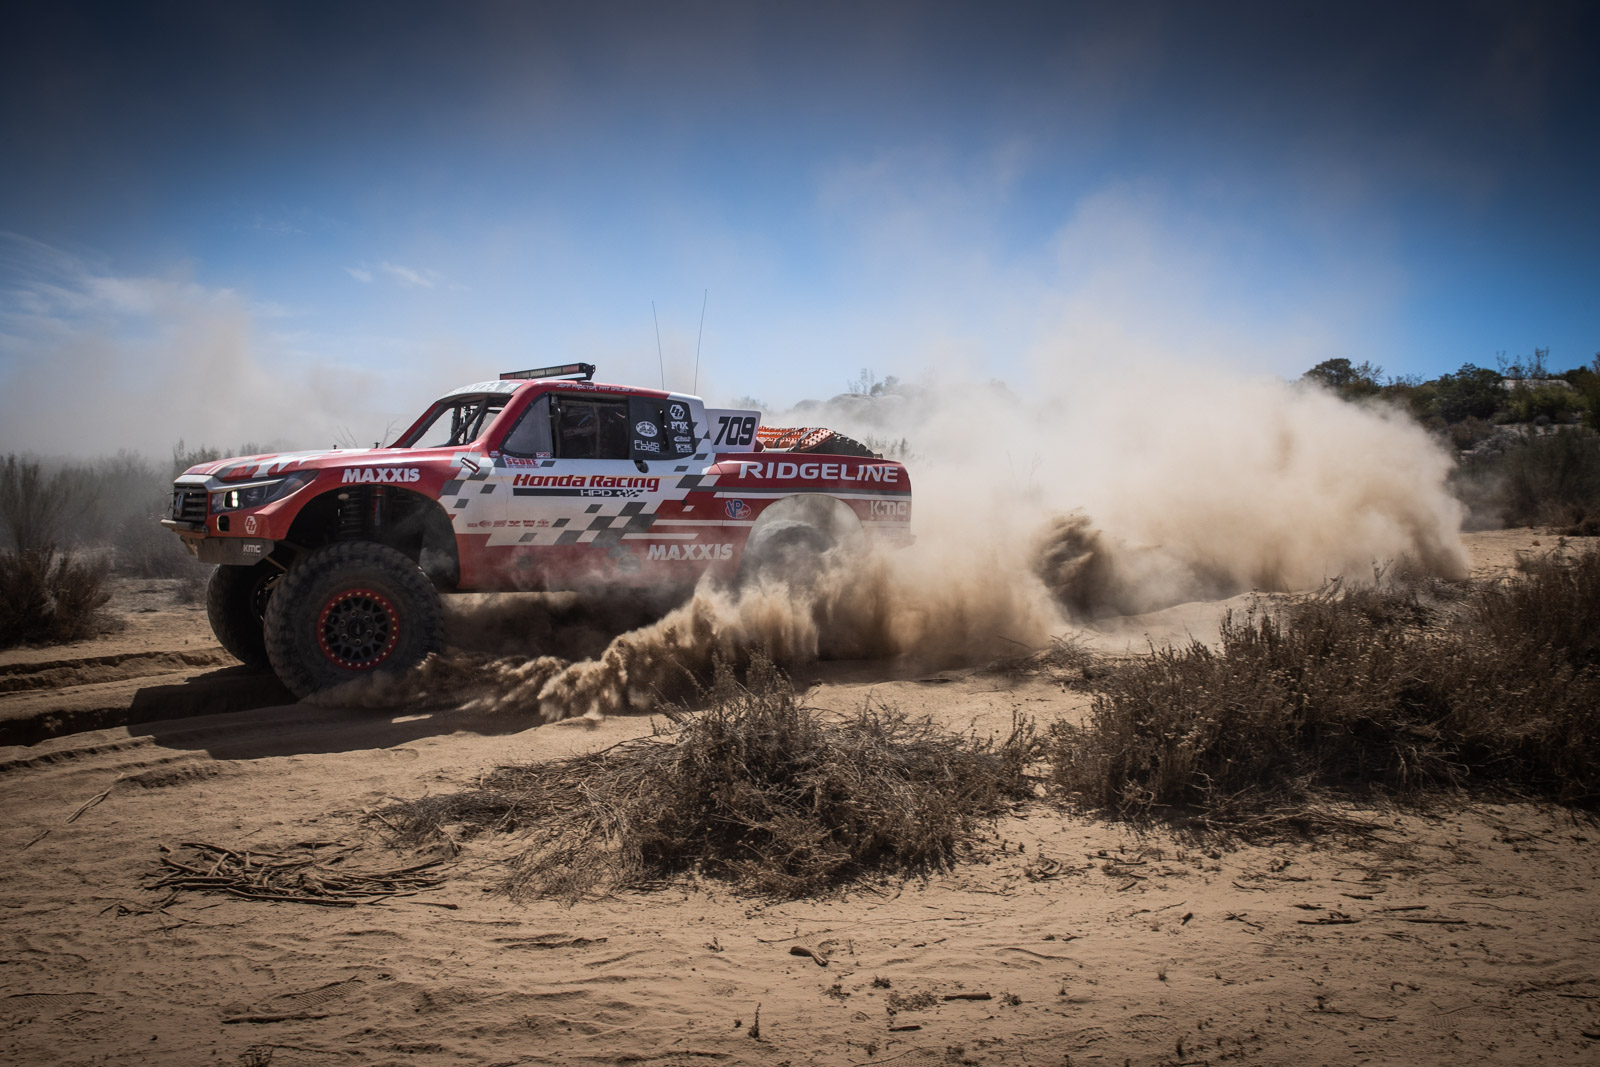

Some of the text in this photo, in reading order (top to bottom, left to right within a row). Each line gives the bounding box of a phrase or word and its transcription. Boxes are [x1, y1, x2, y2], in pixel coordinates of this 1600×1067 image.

[670, 421, 689, 433] FOX
[714, 416, 756, 446] 709
[505, 457, 538, 466] SCORE
[341, 467, 420, 483] MAXXIS
[738, 462, 898, 483] RIDGELINE
[512, 473, 661, 493] Honda Racing
[580, 489, 612, 497] HPD
[725, 499, 744, 518] VP
[646, 543, 734, 561] MAXXIS
